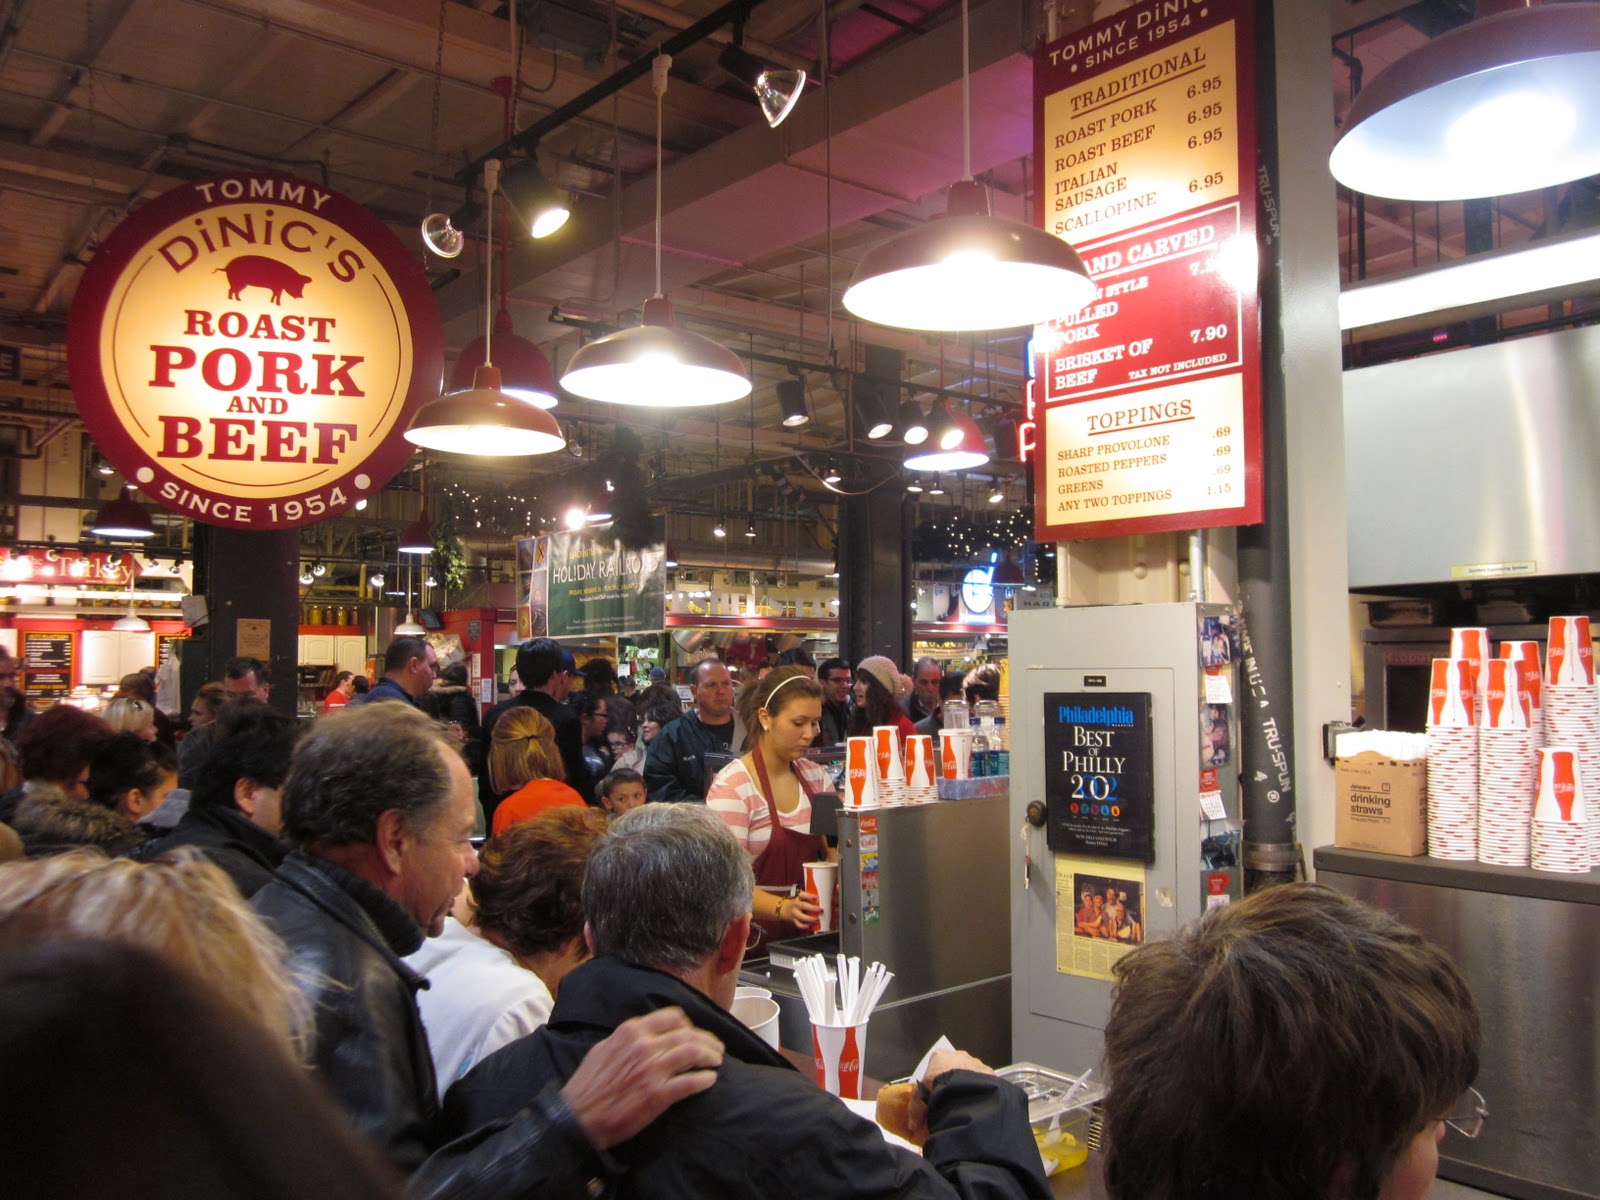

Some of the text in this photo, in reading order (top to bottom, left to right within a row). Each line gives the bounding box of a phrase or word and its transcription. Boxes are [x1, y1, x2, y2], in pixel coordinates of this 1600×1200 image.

[1049, 20, 1127, 67] TOMMY
[1085, 13, 1191, 68] SINCE 1954
[1070, 46, 1206, 112] TRADITIONAL
[1054, 76, 1222, 149] ROAST PORK 6.95
[1054, 102, 1223, 172] ROAST BEEF 6.95
[1055, 127, 1223, 195] ITALIAN 6.95
[195, 178, 332, 211] TOMMY
[1055, 177, 1127, 212] SAUSAGE
[1055, 171, 1224, 235] SCALLOPINE 6.95
[1127, 224, 1215, 264] CARVED
[1105, 275, 1149, 298] STYLE
[183, 309, 336, 344] ROAST
[1055, 324, 1228, 373] BRISKET OF 7.90
[148, 344, 366, 398] PORK
[1055, 352, 1228, 390] BEEF TAX NOT INCLUDED
[225, 395, 289, 415] AND
[1087, 398, 1193, 431] TOPPINGS
[156, 415, 358, 466] BEEF
[1057, 446, 1094, 461] SHARP
[1097, 434, 1171, 455] PROVOLONE
[1057, 461, 1110, 478] ROASTED
[1113, 453, 1167, 471] PEPPERS
[160, 481, 348, 523] SINCE 1954
[1057, 480, 1104, 495] GREENS
[1057, 483, 1232, 512] ANY TWO TOPPINGS 1.15
[1058, 706, 1135, 727] Philadelphia
[1073, 726, 1115, 748] BEST
[1088, 747, 1100, 757] OF
[1062, 751, 1126, 774] PHILLY
[1350, 793, 1391, 808] drinking
[1350, 804, 1383, 816] straws
